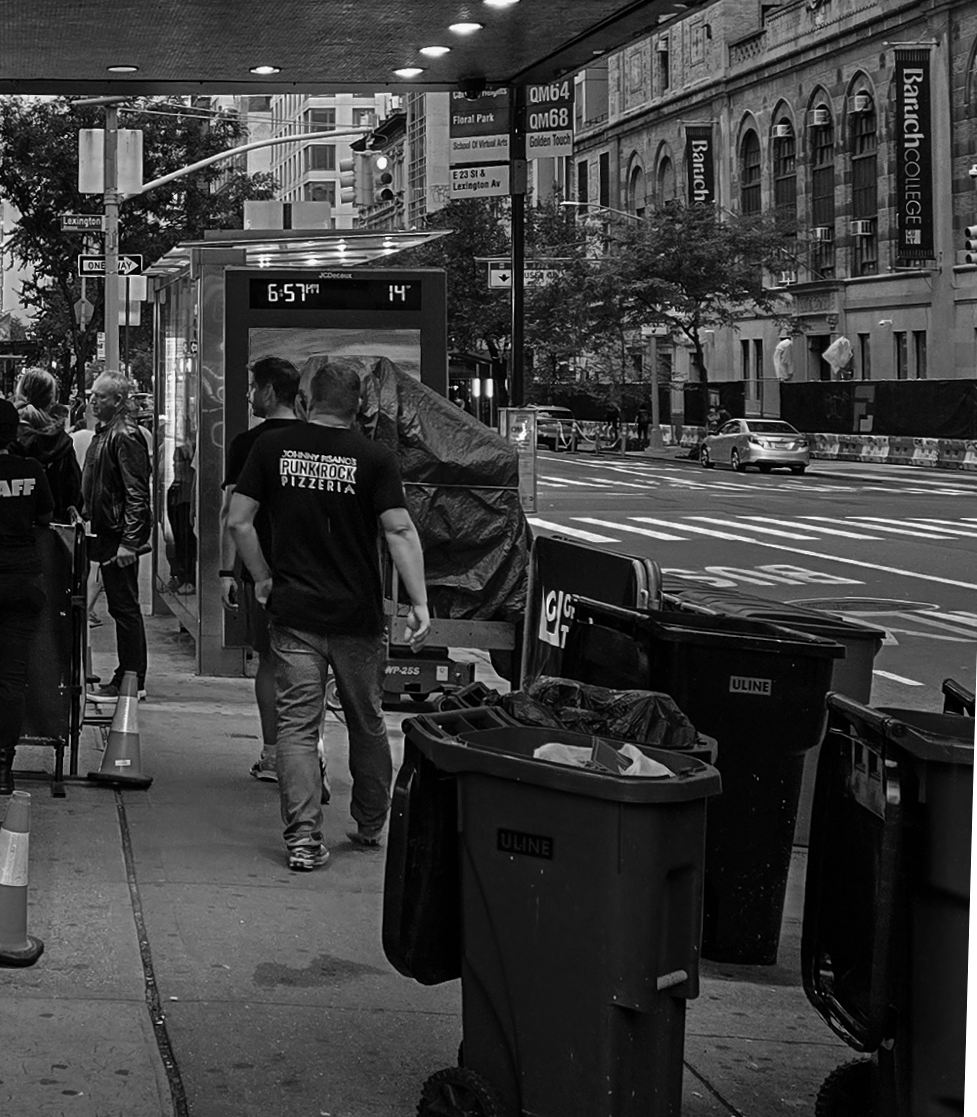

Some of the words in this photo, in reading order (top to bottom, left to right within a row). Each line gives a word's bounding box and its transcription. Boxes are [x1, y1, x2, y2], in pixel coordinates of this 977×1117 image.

[529, 81, 570, 103] QM64
[903, 68, 925, 148] Baruch
[453, 114, 475, 125] Floral
[476, 113, 495, 123] Park
[529, 108, 569, 130] QM68
[453, 141, 471, 151] School
[497, 138, 508, 147] Arts
[529, 135, 551, 148] Golden
[552, 133, 571, 146] Touch
[453, 171, 458, 180] E
[459, 170, 469, 179] 23
[470, 170, 479, 178] St
[480, 169, 486, 178] &
[692, 140, 709, 201] Baruch
[453, 182, 489, 191] Lexington
[490, 179, 501, 188] Av
[904, 148, 922, 225] COLLEGE
[63, 216, 101, 228] Lexington
[88, 262, 105, 270] ONE
[281, 449, 320, 462] JOHNNY
[280, 458, 320, 479] PUNK
[319, 463, 357, 484] ROCK
[281, 475, 356, 495] PIZZERIA
[732, 678, 770, 693] ULINE
[499, 831, 551, 857] ULINE
